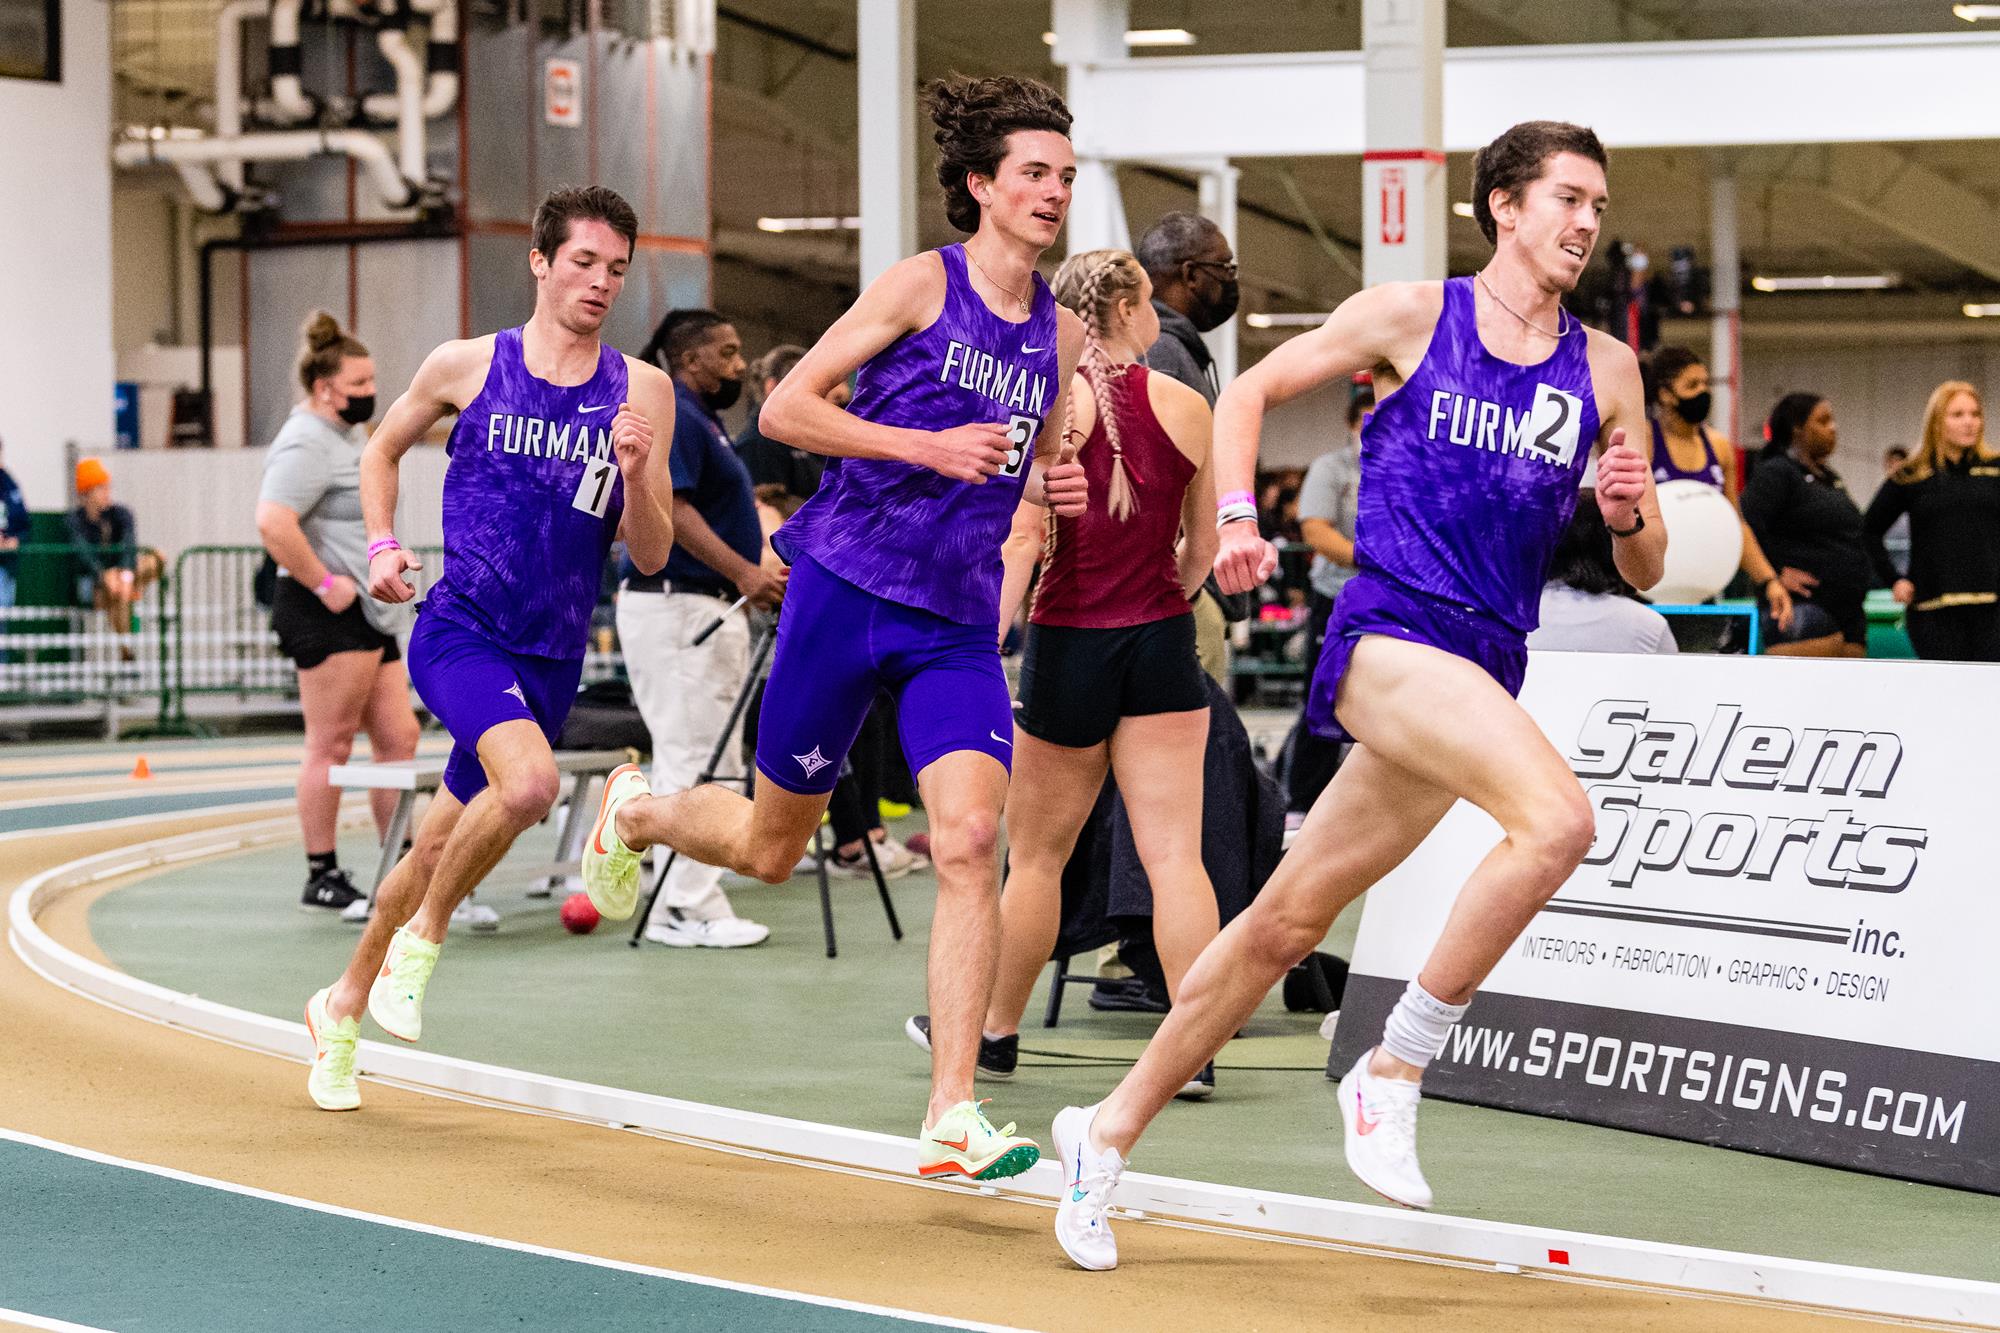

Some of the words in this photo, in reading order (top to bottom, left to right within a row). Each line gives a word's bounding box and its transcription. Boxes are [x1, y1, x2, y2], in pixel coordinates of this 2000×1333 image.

[939, 340, 1047, 417] FURMAN
[487, 413, 614, 464] FURMAN
[1005, 420, 1031, 474] 3
[1427, 389, 1571, 470] FURM
[1533, 393, 1569, 456] 2
[590, 465, 611, 512] 1
[1568, 699, 1903, 799] Salem
[1581, 784, 1928, 894] Sports
[1521, 934, 1597, 966] INTERIORS
[1612, 946, 1711, 979] FABRICATION
[1728, 959, 1808, 991] GRAPHICS
[1825, 970, 1890, 1002] DESIGN
[1852, 918, 1906, 959] inc.
[1435, 1022, 1967, 1144] WW.SPORTSIGNS.COM
